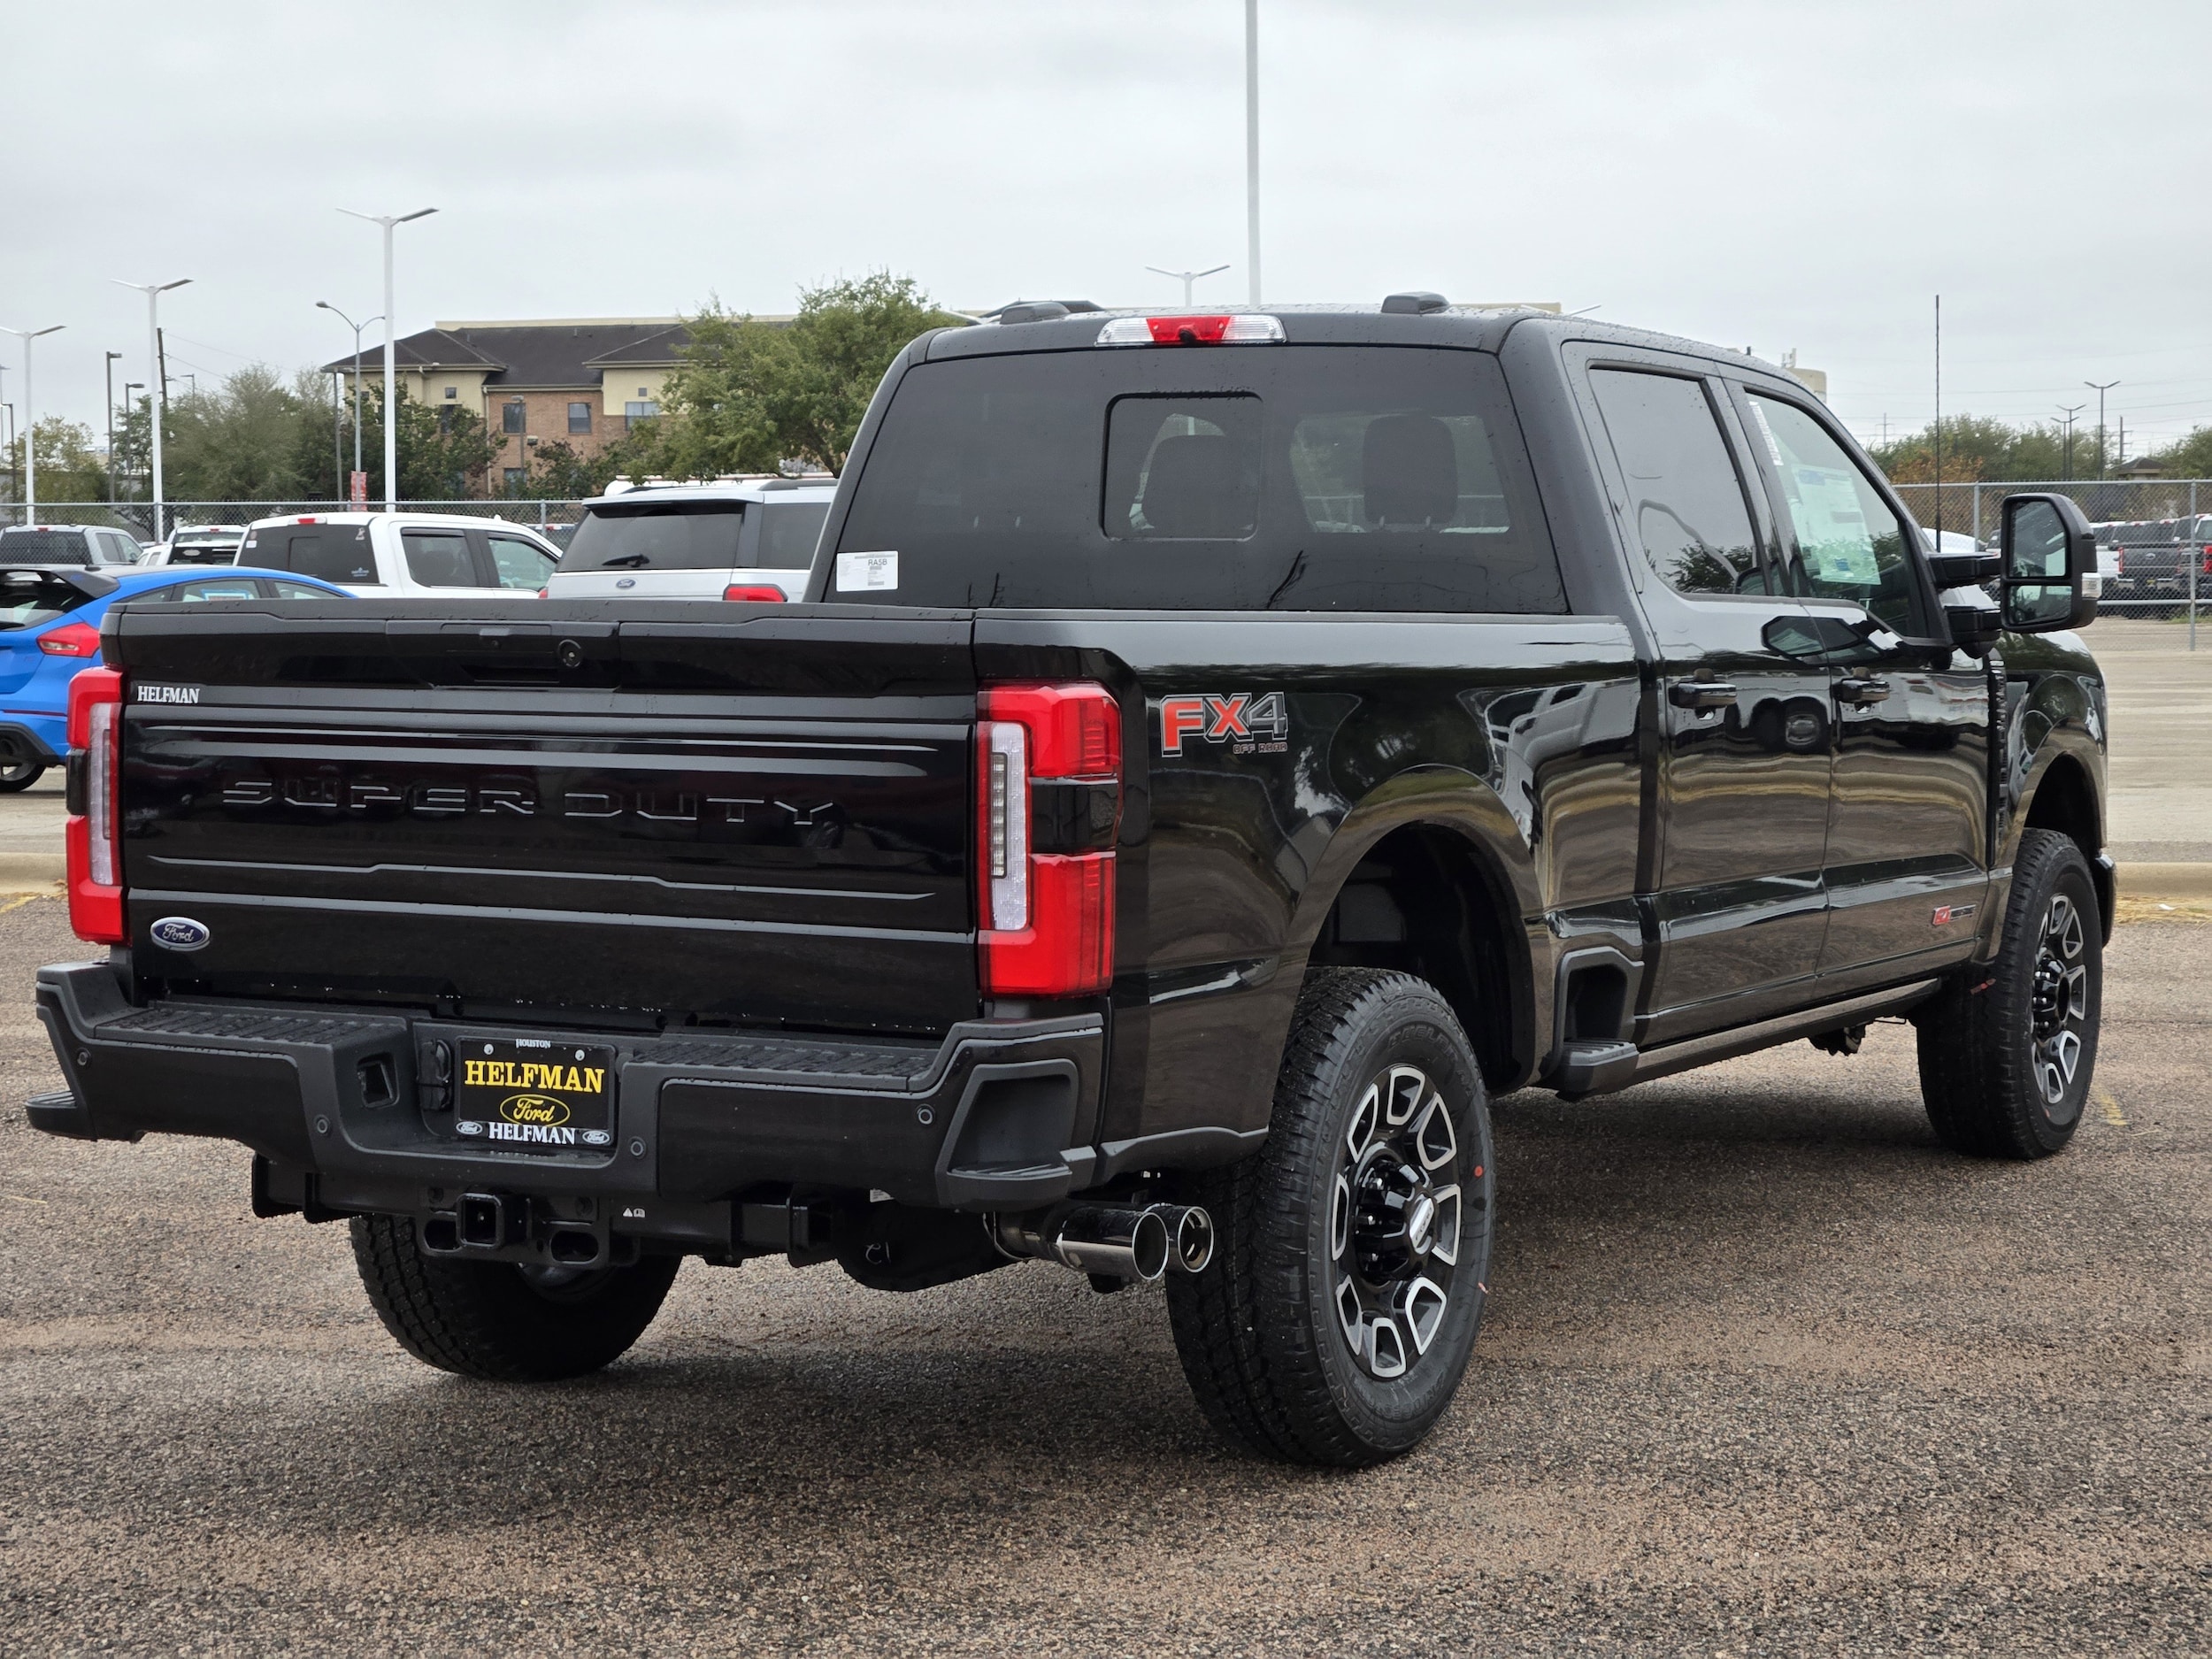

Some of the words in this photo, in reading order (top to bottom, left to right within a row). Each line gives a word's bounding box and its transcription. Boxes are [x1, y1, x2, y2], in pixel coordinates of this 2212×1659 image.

[137, 686, 200, 703] HELFMAN
[1161, 692, 1288, 757] FX4
[1233, 744, 1256, 754] OFF
[1258, 742, 1288, 753] ROAD
[222, 780, 534, 814] SUPER
[565, 792, 833, 825] DUTY
[163, 924, 195, 943] Ford
[515, 1039, 551, 1048] HOUSTON
[465, 1060, 604, 1093] HELFMAN
[513, 1097, 556, 1122] Ford
[488, 1122, 575, 1145] HELFMAN
